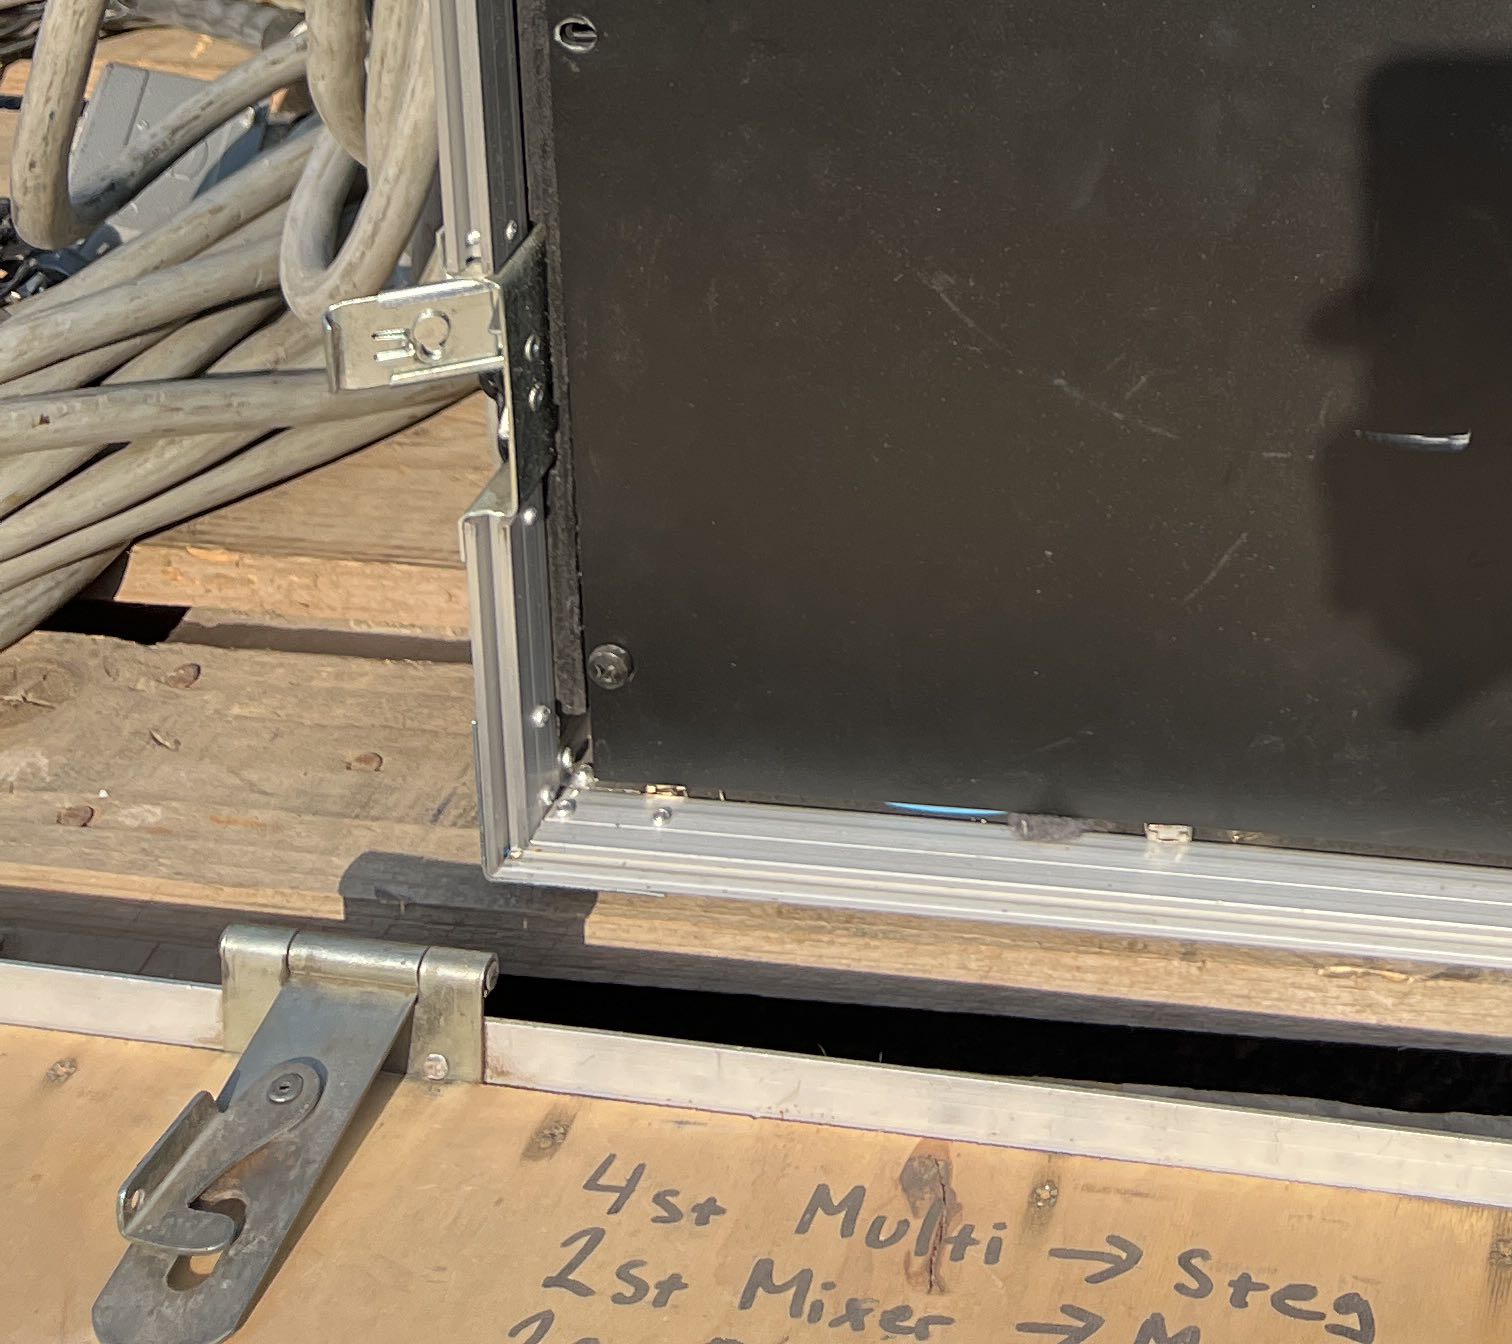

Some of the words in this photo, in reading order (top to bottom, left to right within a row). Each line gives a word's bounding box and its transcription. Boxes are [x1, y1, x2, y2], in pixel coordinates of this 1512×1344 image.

[738, 1257, 956, 1341] Mixer
[794, 1183, 1008, 1266] Multi
[1173, 1247, 1376, 1344] Steg
